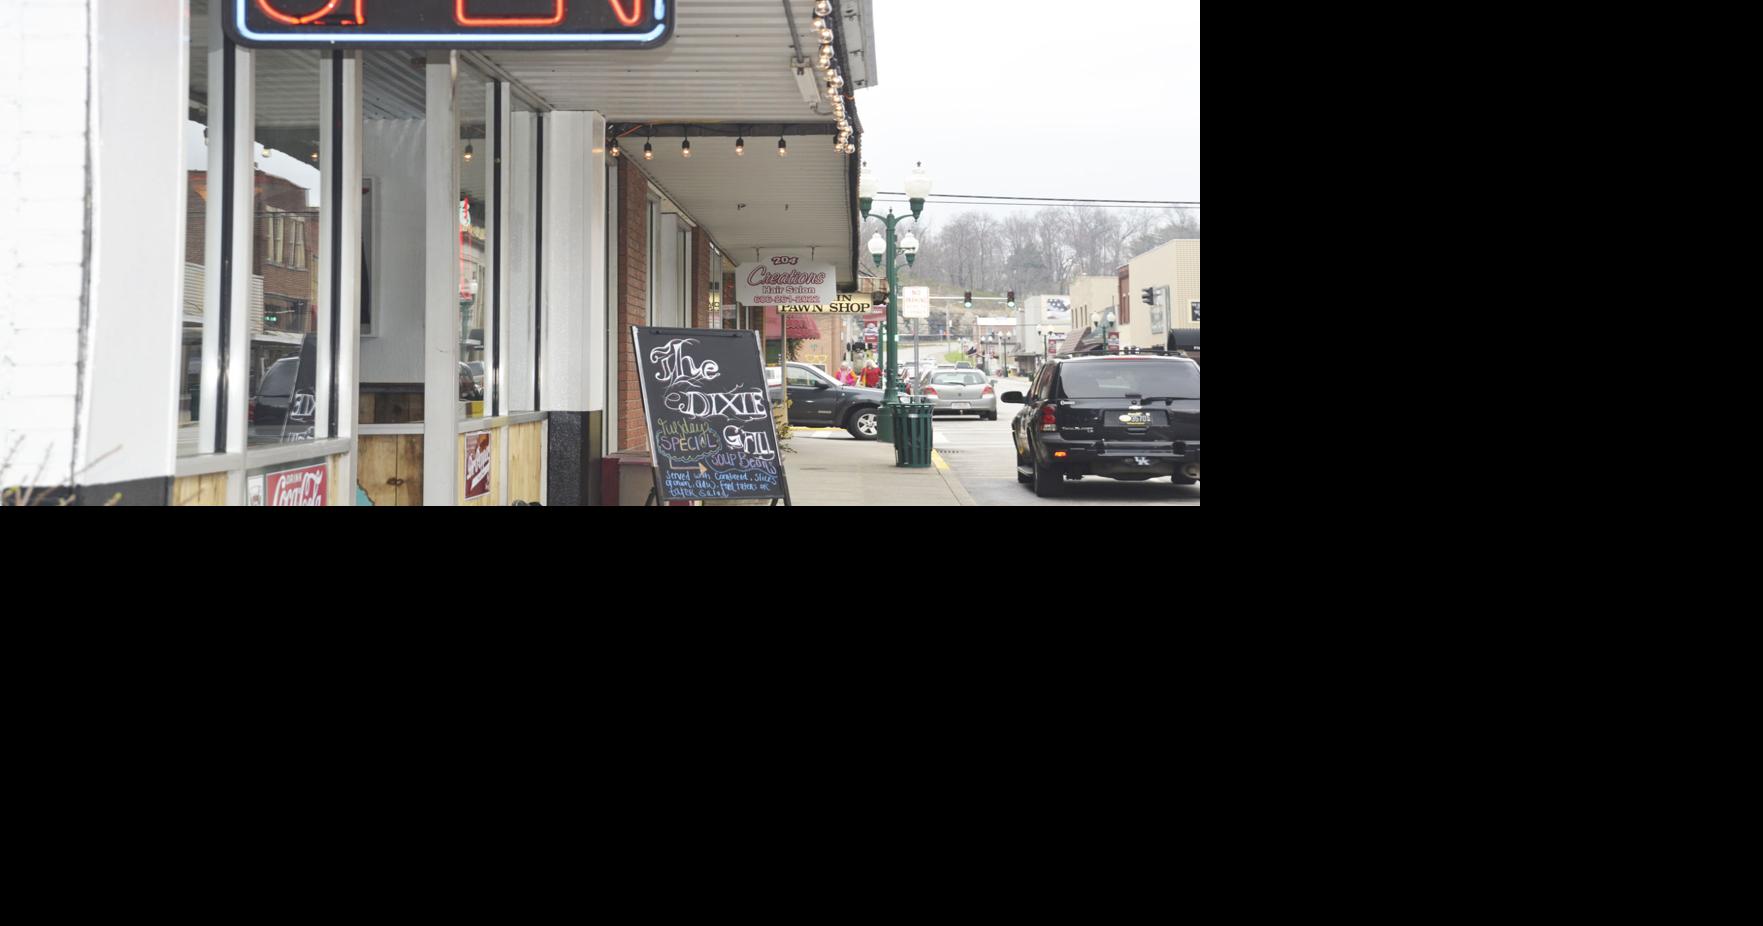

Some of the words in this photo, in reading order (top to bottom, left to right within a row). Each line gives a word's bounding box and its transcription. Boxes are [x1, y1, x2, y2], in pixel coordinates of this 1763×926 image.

[771, 256, 798, 265] 204
[747, 264, 826, 286] Creations
[762, 286, 784, 294] Hair
[785, 286, 816, 294] Salon
[781, 304, 823, 312] PAWN
[829, 303, 870, 313] SHOP
[650, 338, 720, 383] The
[668, 387, 768, 420] DIXIE
[660, 435, 717, 451] SPECIAL
